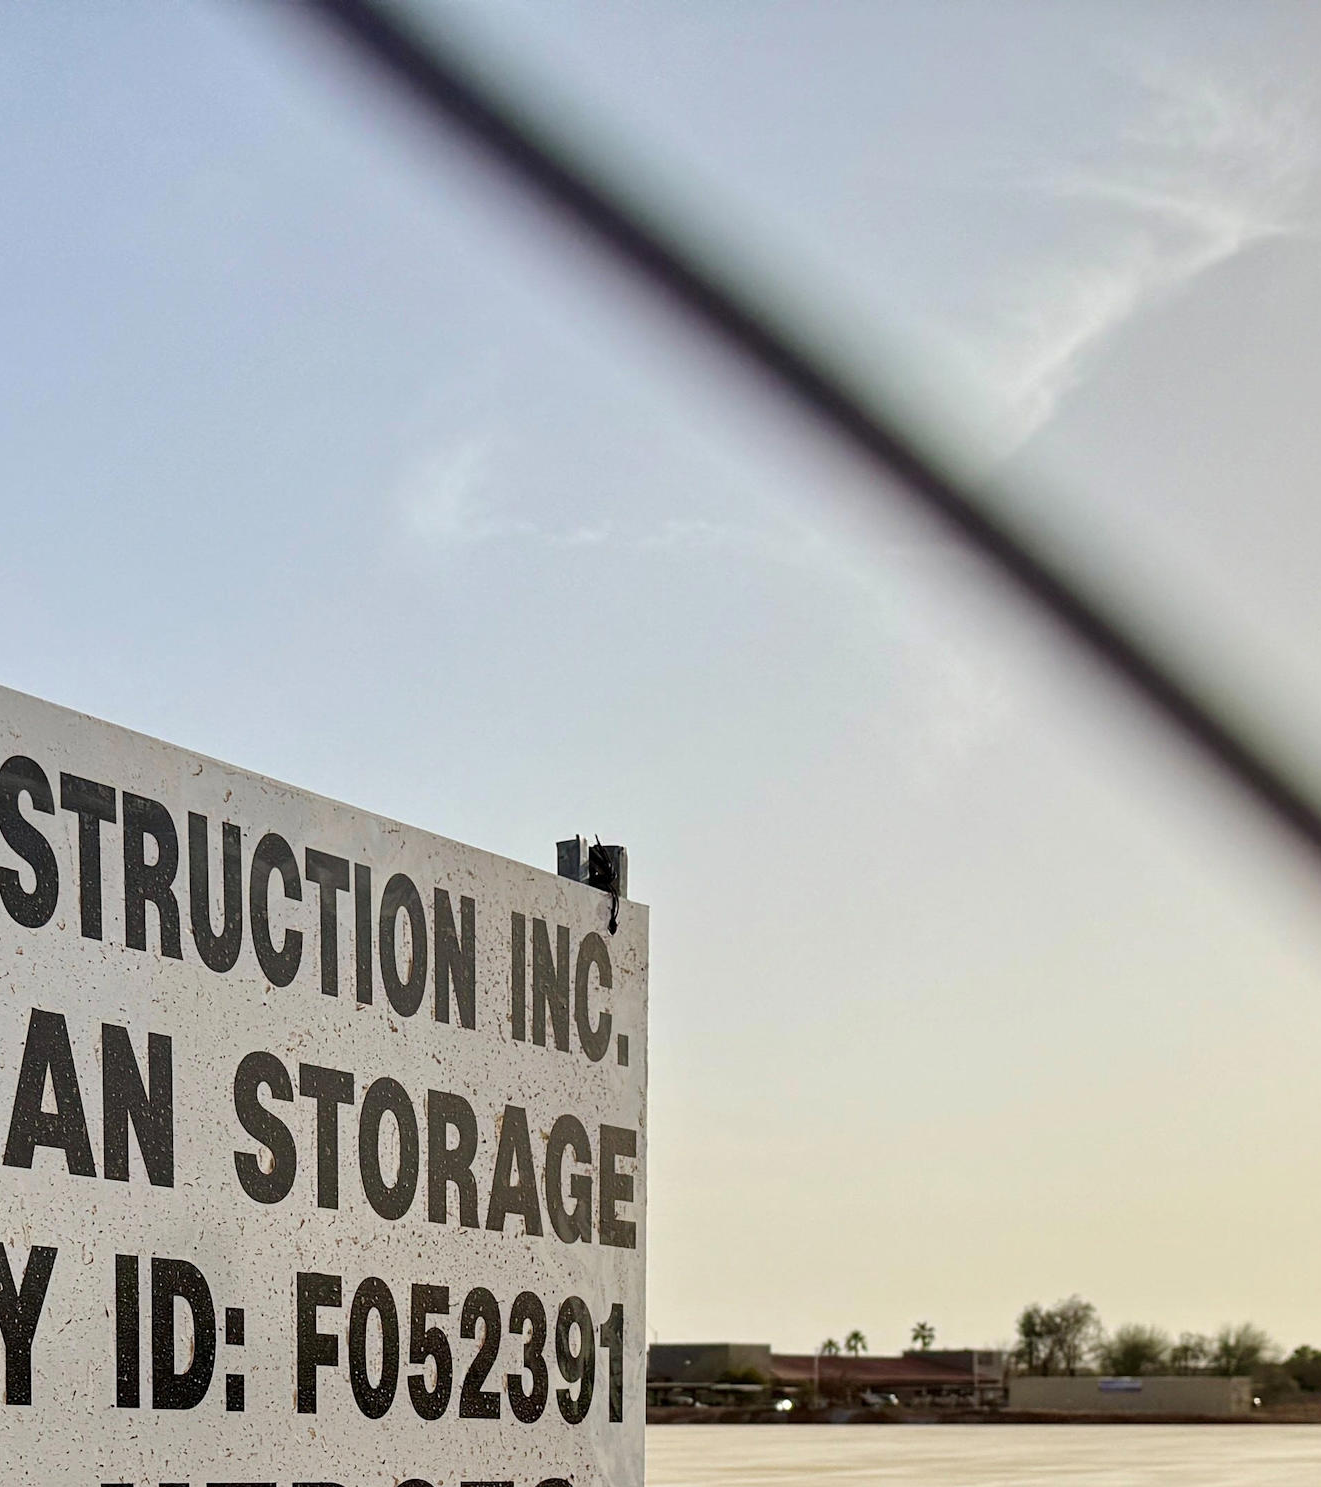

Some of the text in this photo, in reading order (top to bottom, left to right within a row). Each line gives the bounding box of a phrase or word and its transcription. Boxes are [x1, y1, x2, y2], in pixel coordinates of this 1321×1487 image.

[511, 910, 630, 1066] INC.
[234, 1052, 638, 1250] STORAGE
[116, 1254, 246, 1412] ID:
[296, 1272, 625, 1423] F052391
